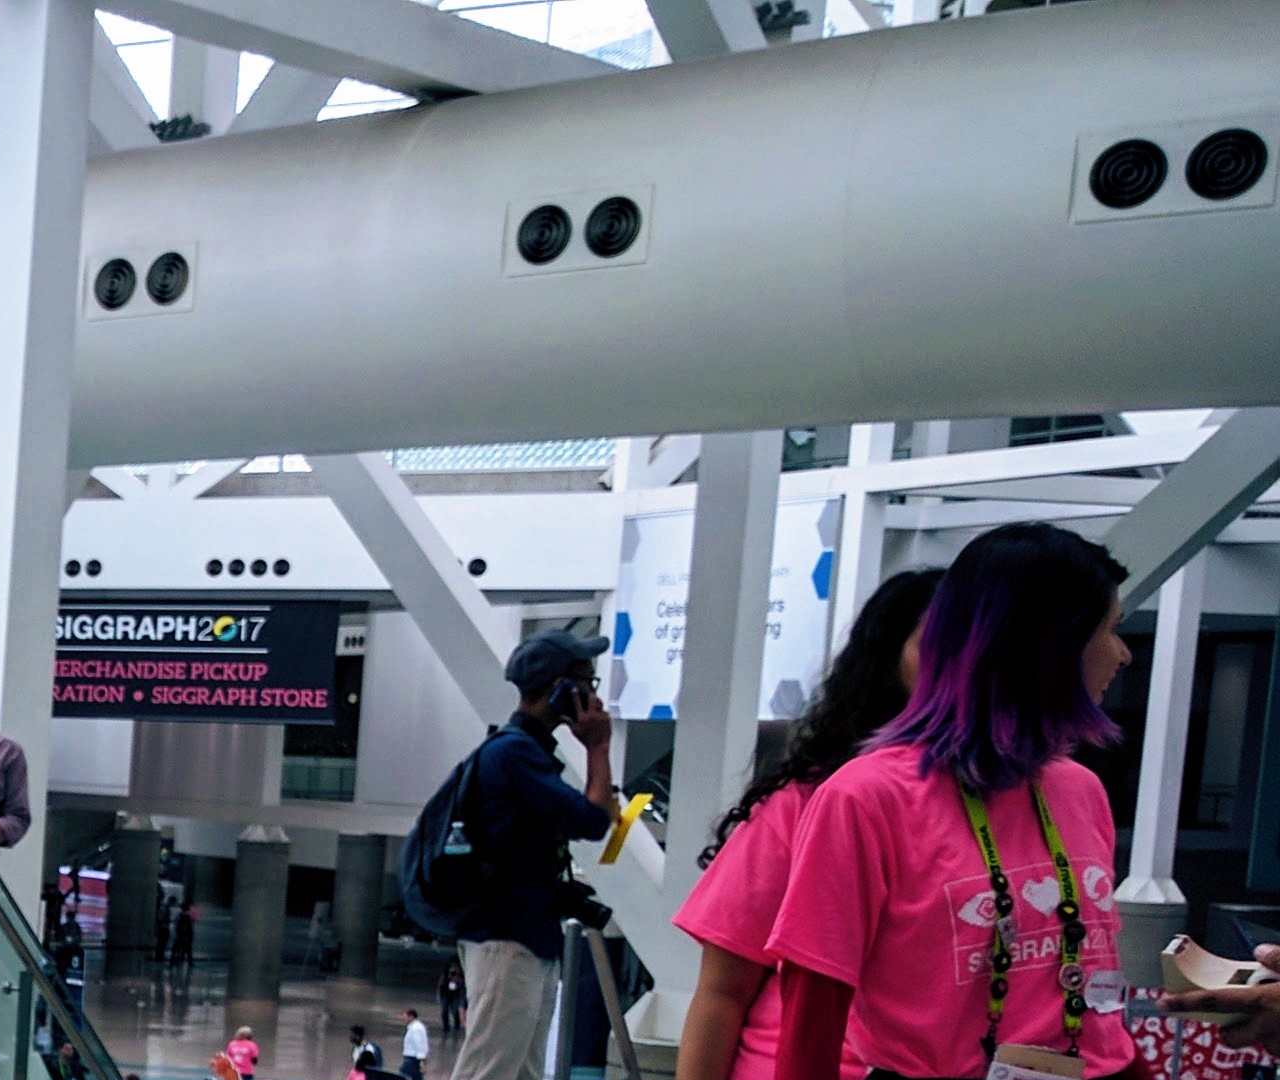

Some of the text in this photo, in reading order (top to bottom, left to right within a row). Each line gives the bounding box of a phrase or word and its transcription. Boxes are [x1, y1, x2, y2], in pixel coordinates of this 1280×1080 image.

[189, 662, 269, 682] PICKUP
[151, 686, 257, 706] SIGGRAPH
[259, 688, 329, 709] STORE
